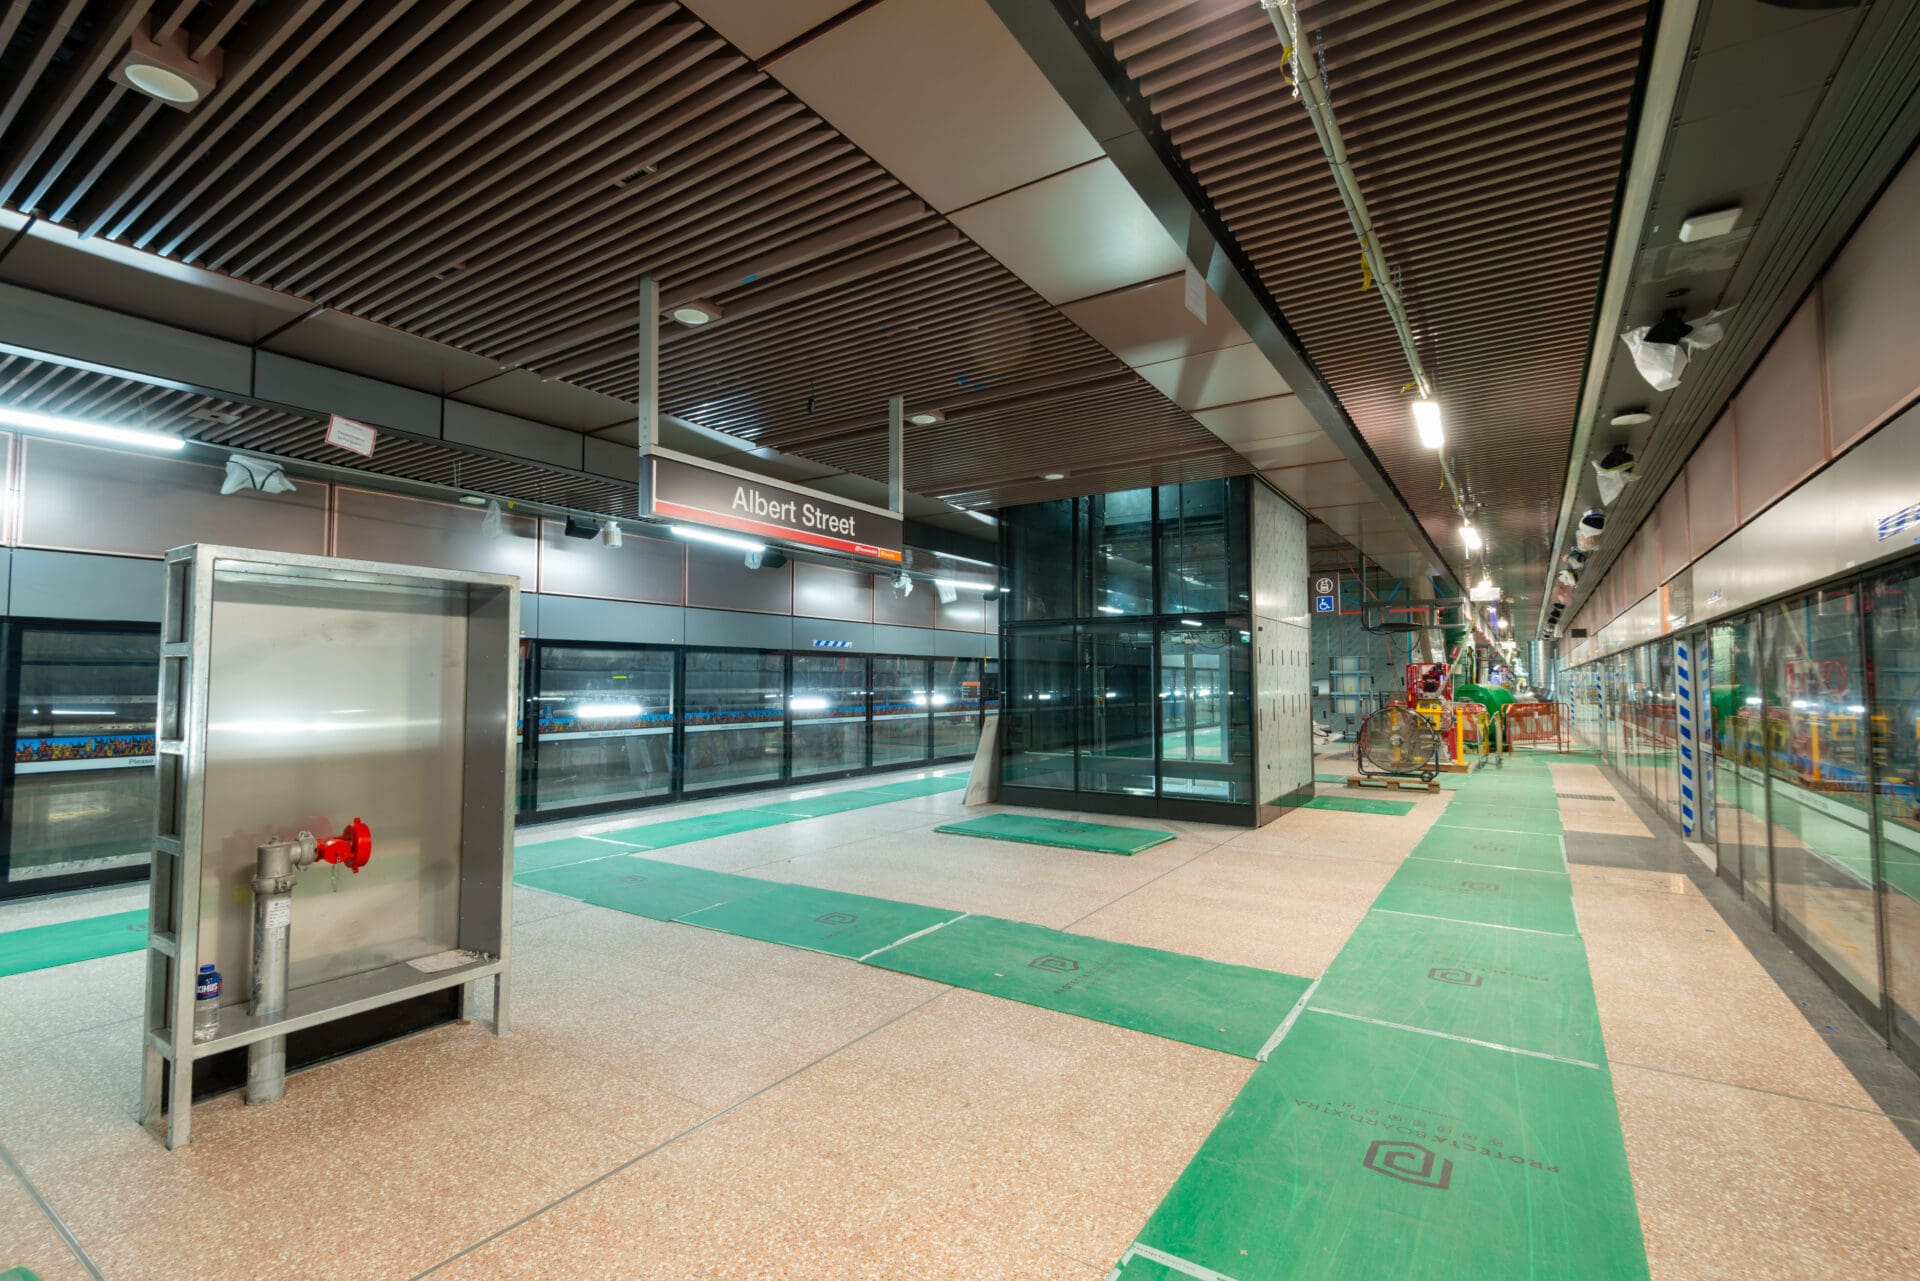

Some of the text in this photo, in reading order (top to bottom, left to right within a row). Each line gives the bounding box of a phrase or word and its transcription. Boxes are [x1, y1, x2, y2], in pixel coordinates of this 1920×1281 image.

[732, 486, 856, 536] Albert Street
[1435, 1135, 1559, 1173] PROTECTA
